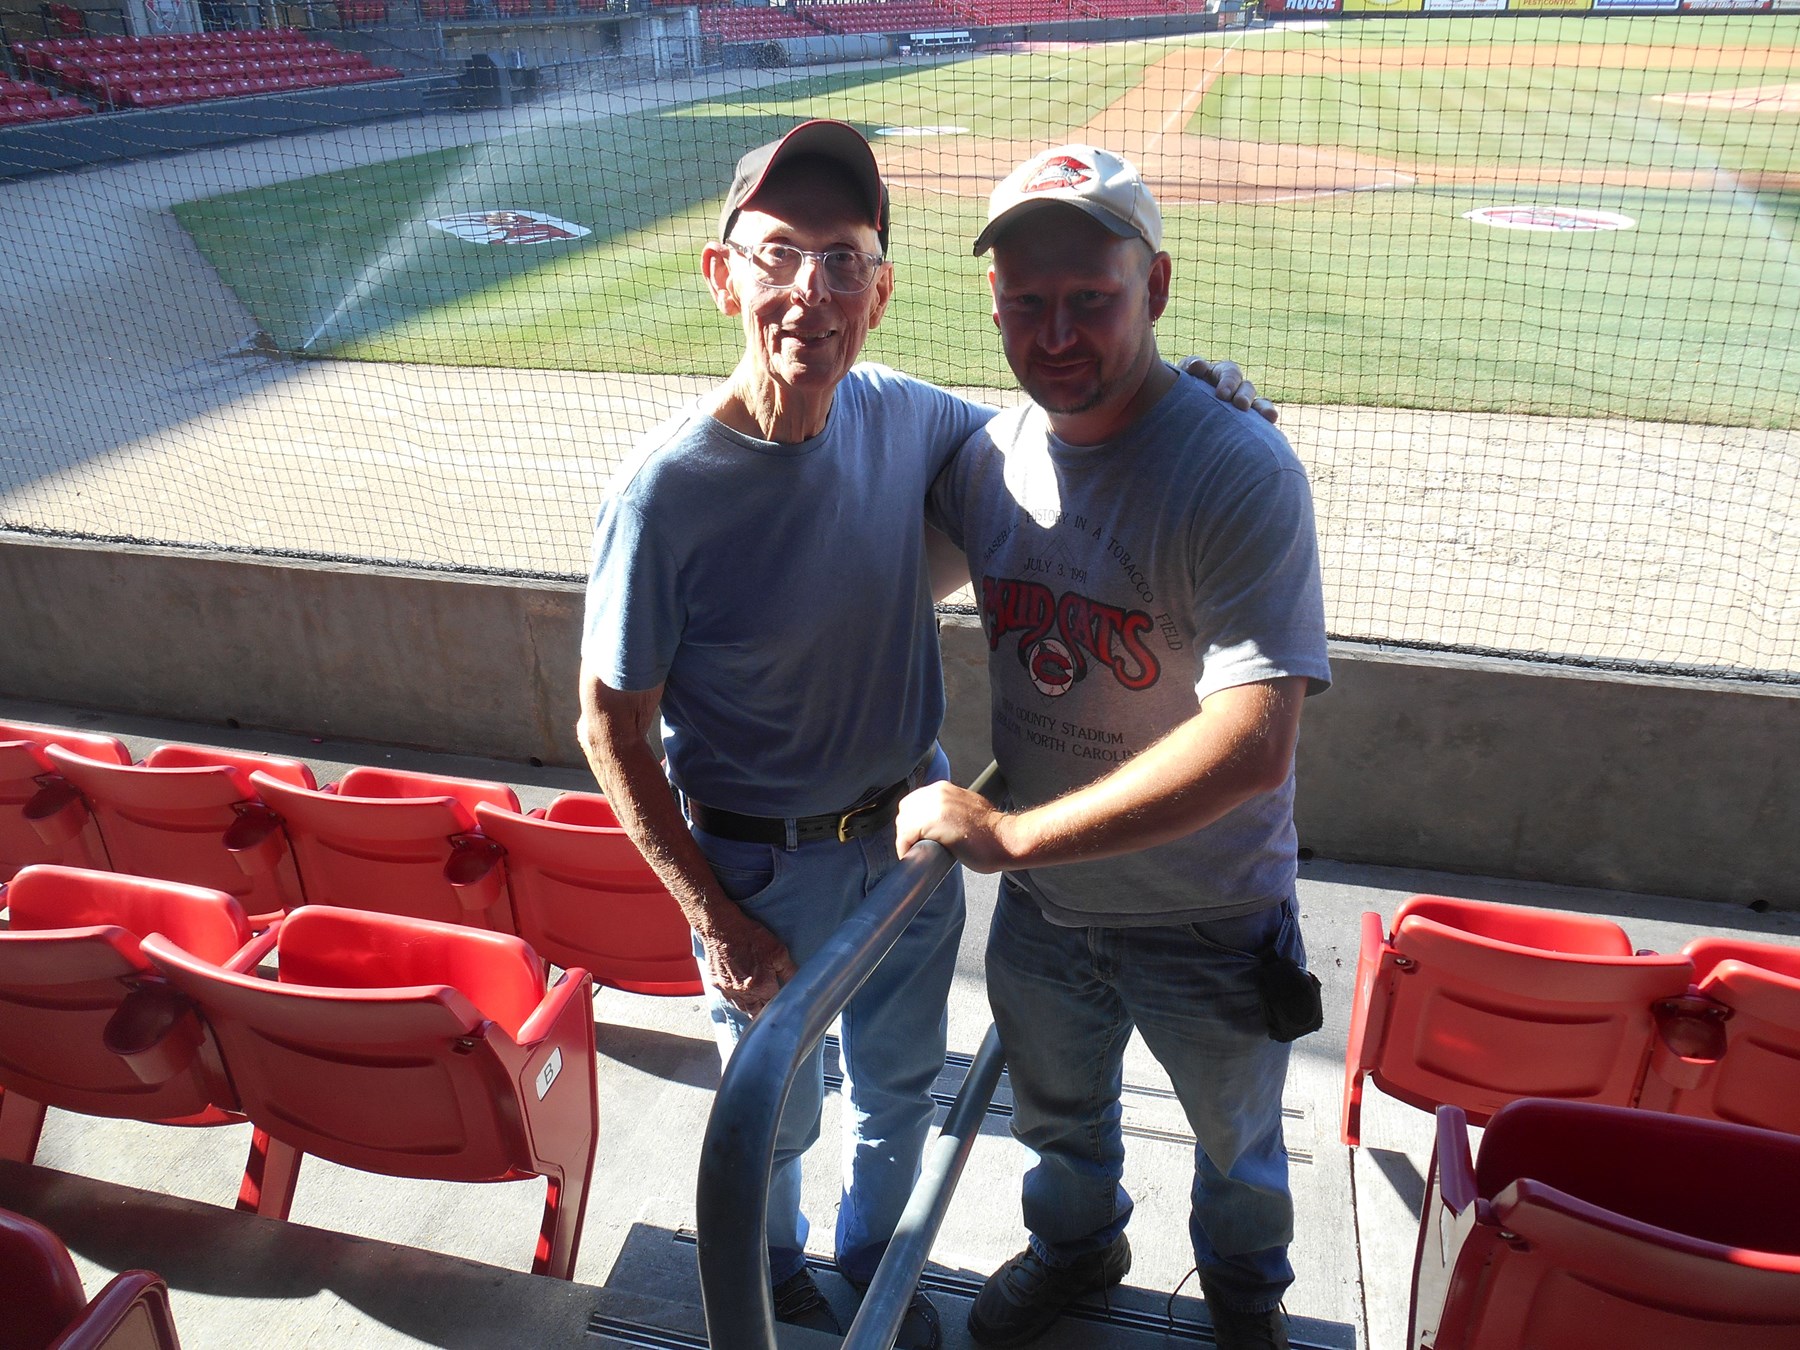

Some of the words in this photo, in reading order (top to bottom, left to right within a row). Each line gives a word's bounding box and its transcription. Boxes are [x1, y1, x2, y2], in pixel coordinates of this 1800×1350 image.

[1024, 558, 1052, 573] JULY
[1071, 567, 1087, 584] 1991
[1074, 515, 1087, 530] IN
[1092, 527, 1102, 540] A
[1106, 536, 1154, 604] TOBACCO
[1155, 612, 1183, 652] FIELD
[1016, 707, 1056, 731] COUNTY
[1061, 722, 1124, 745] STADIUM
[1026, 730, 1065, 753] NORTH
[1072, 744, 1138, 763] CAROLIN
[543, 1062, 554, 1085] B
